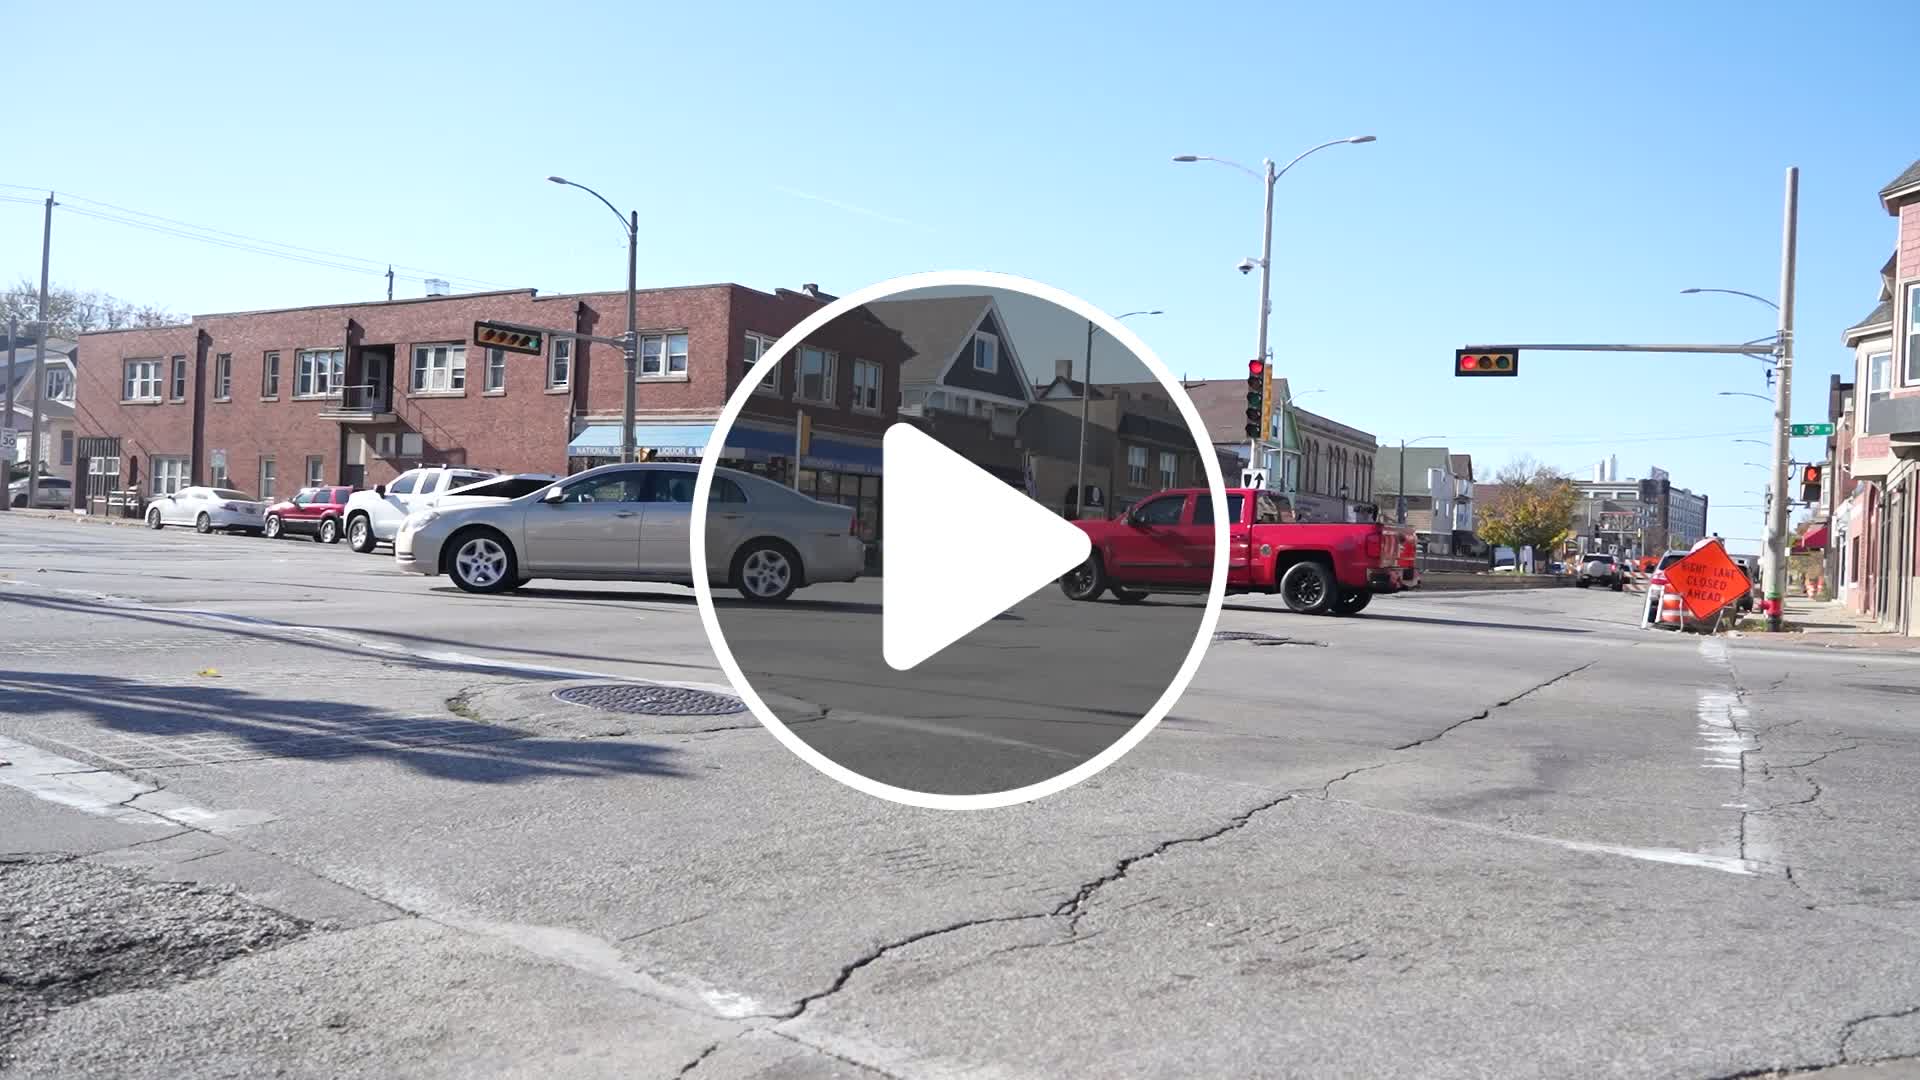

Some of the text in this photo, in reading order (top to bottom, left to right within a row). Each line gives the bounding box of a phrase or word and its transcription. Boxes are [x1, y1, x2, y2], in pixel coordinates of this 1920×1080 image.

[3, 437, 16, 446] 30
[576, 447, 612, 456] NATIONAL
[657, 447, 686, 456] LIQUOR
[1687, 575, 1727, 591] CLOSED
[1686, 588, 1721, 602] AHEAD
